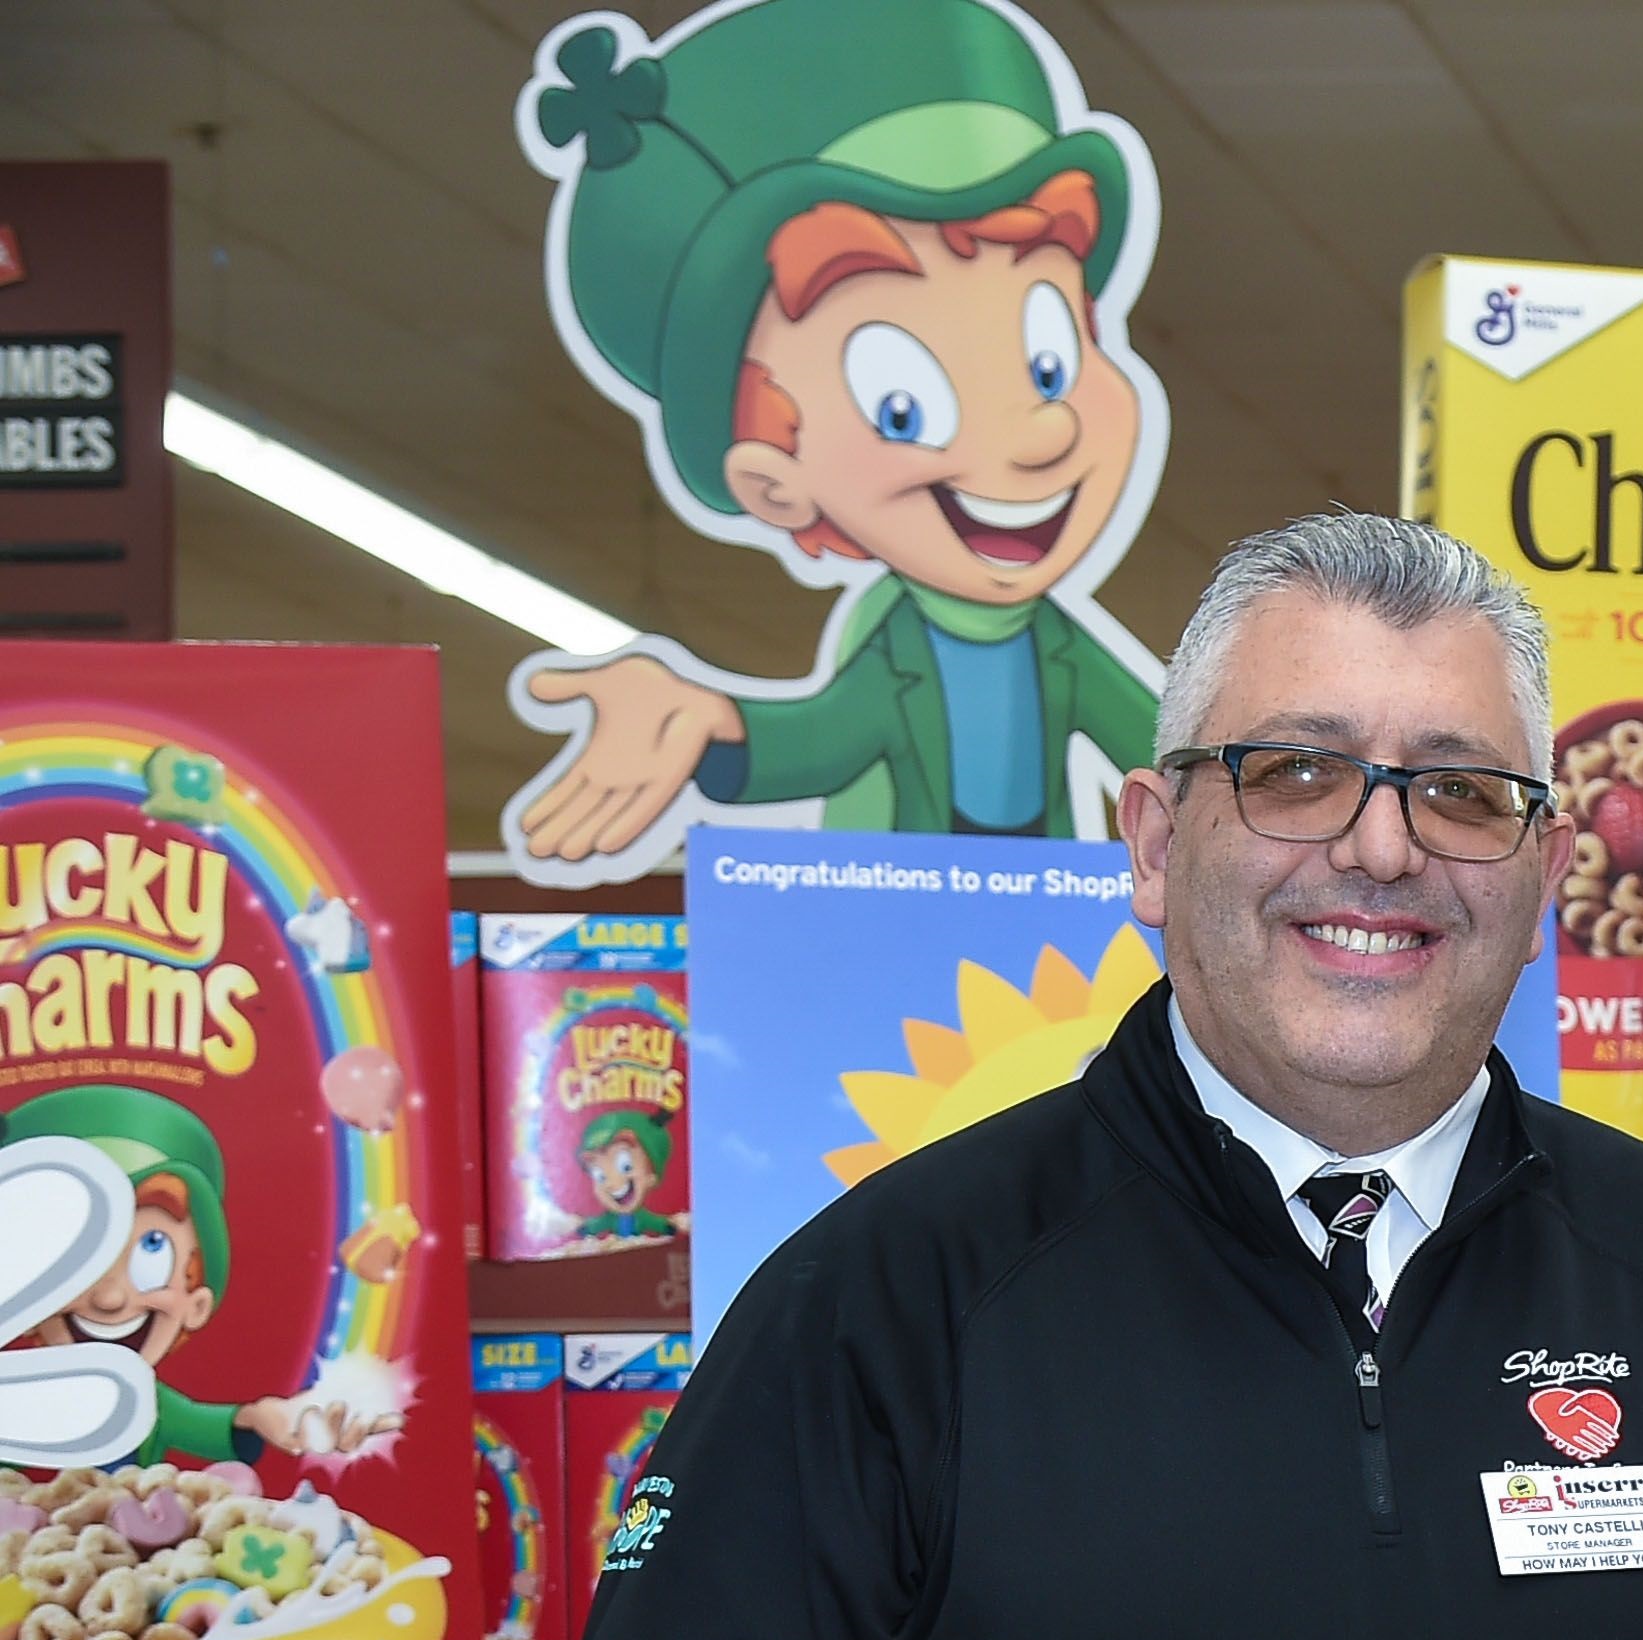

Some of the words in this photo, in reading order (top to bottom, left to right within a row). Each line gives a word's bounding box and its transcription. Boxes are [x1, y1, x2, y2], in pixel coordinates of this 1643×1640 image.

[0, 419, 116, 473] BLES
[714, 855, 942, 891] Congratulations
[950, 866, 980, 892] to
[989, 873, 1037, 895] our
[0, 833, 229, 960] ucky
[1501, 1350, 1630, 1388] ShopRite
[1564, 1496, 1643, 1509] SUPERMARKETS
[1528, 1524, 1568, 1536] TONY
[1574, 1520, 1643, 1534] CASTELLI
[1585, 1538, 1632, 1548] MANAGER
[1523, 1558, 1555, 1571] HOW
[1560, 1556, 1588, 1569] MAY
[1600, 1555, 1629, 1566] HELP
